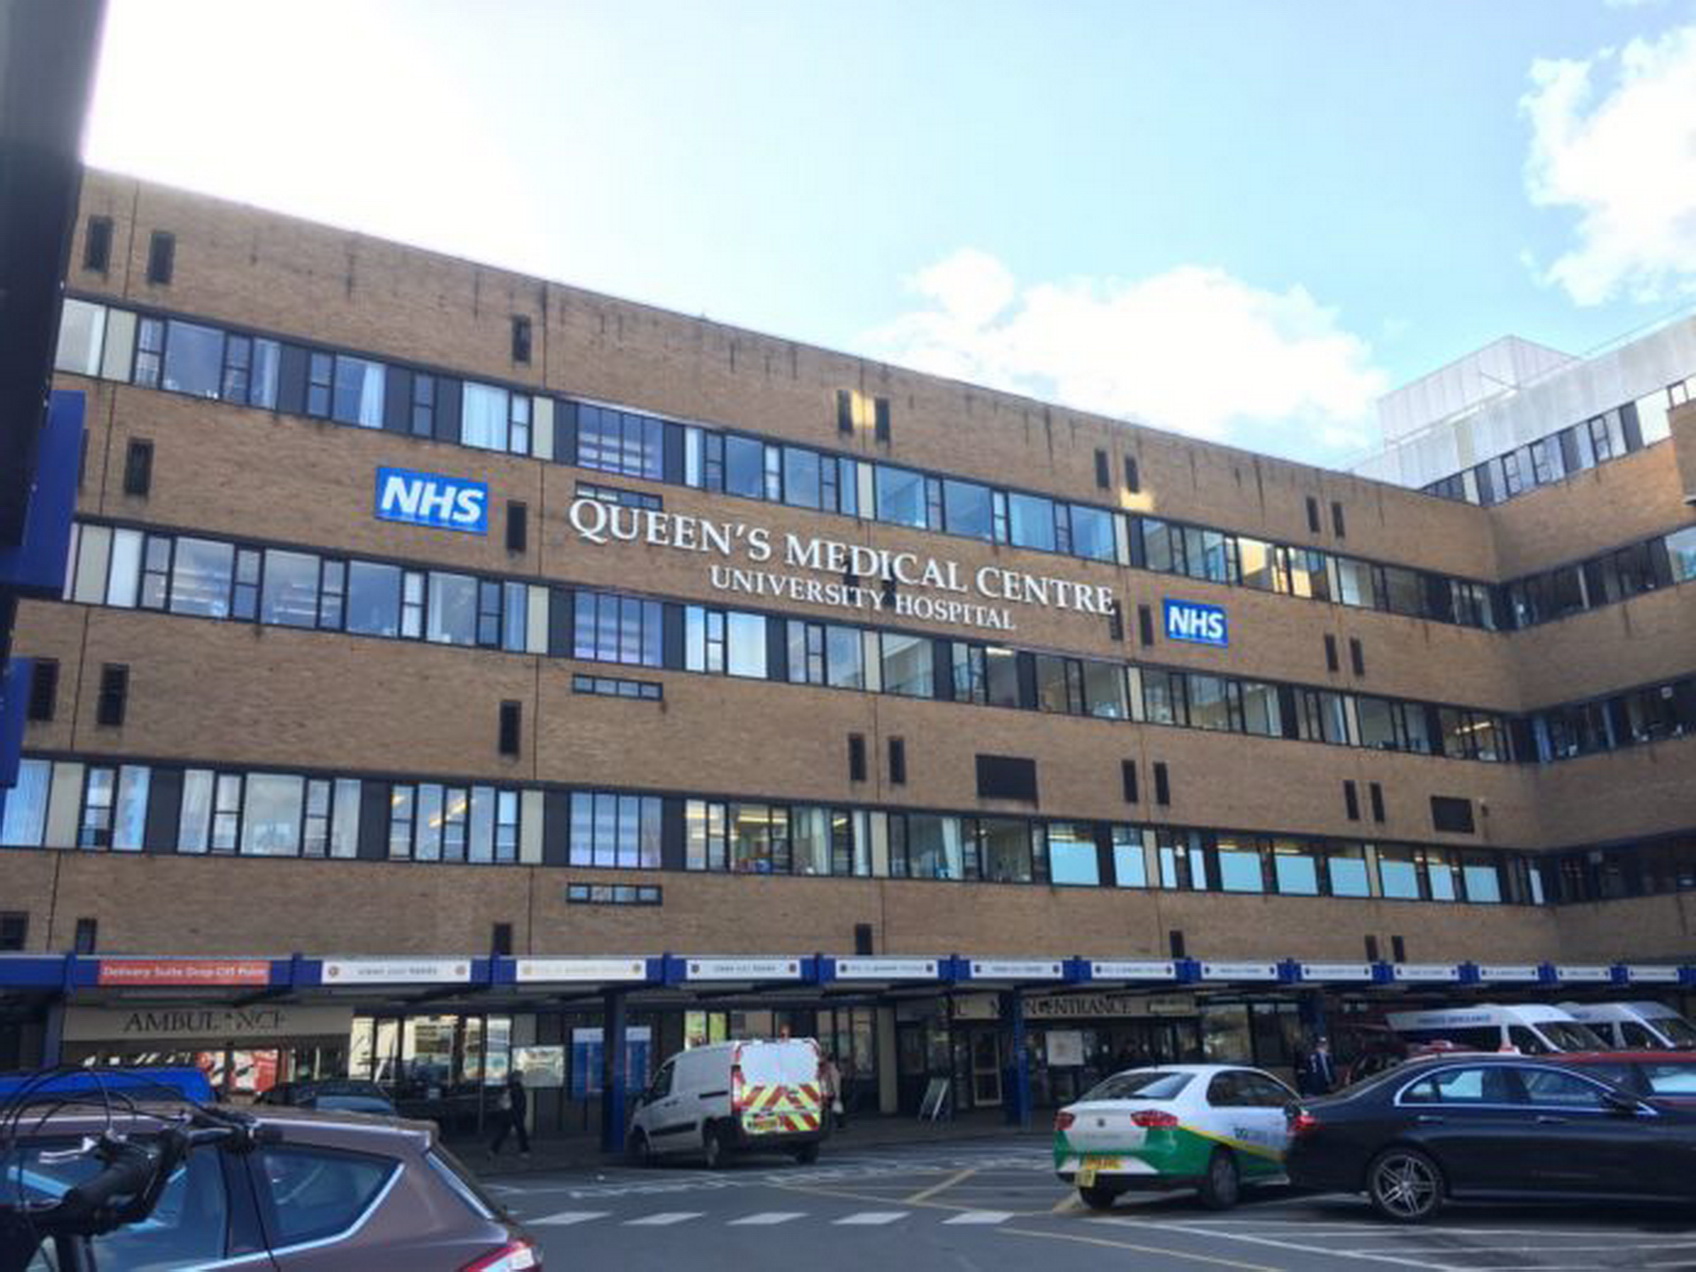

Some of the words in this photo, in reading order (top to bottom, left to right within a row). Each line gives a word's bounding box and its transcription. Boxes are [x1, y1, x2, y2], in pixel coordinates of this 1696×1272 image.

[380, 475, 485, 524] NHS
[568, 497, 771, 561] QUEEN'S
[784, 532, 967, 593] MEDICAL
[975, 566, 1116, 616] CENTRE
[710, 563, 887, 611] UNIVERSITY
[894, 596, 1017, 631] HOSPITAL
[1168, 606, 1225, 639] NHS
[123, 1010, 287, 1032] AMBULNCE
